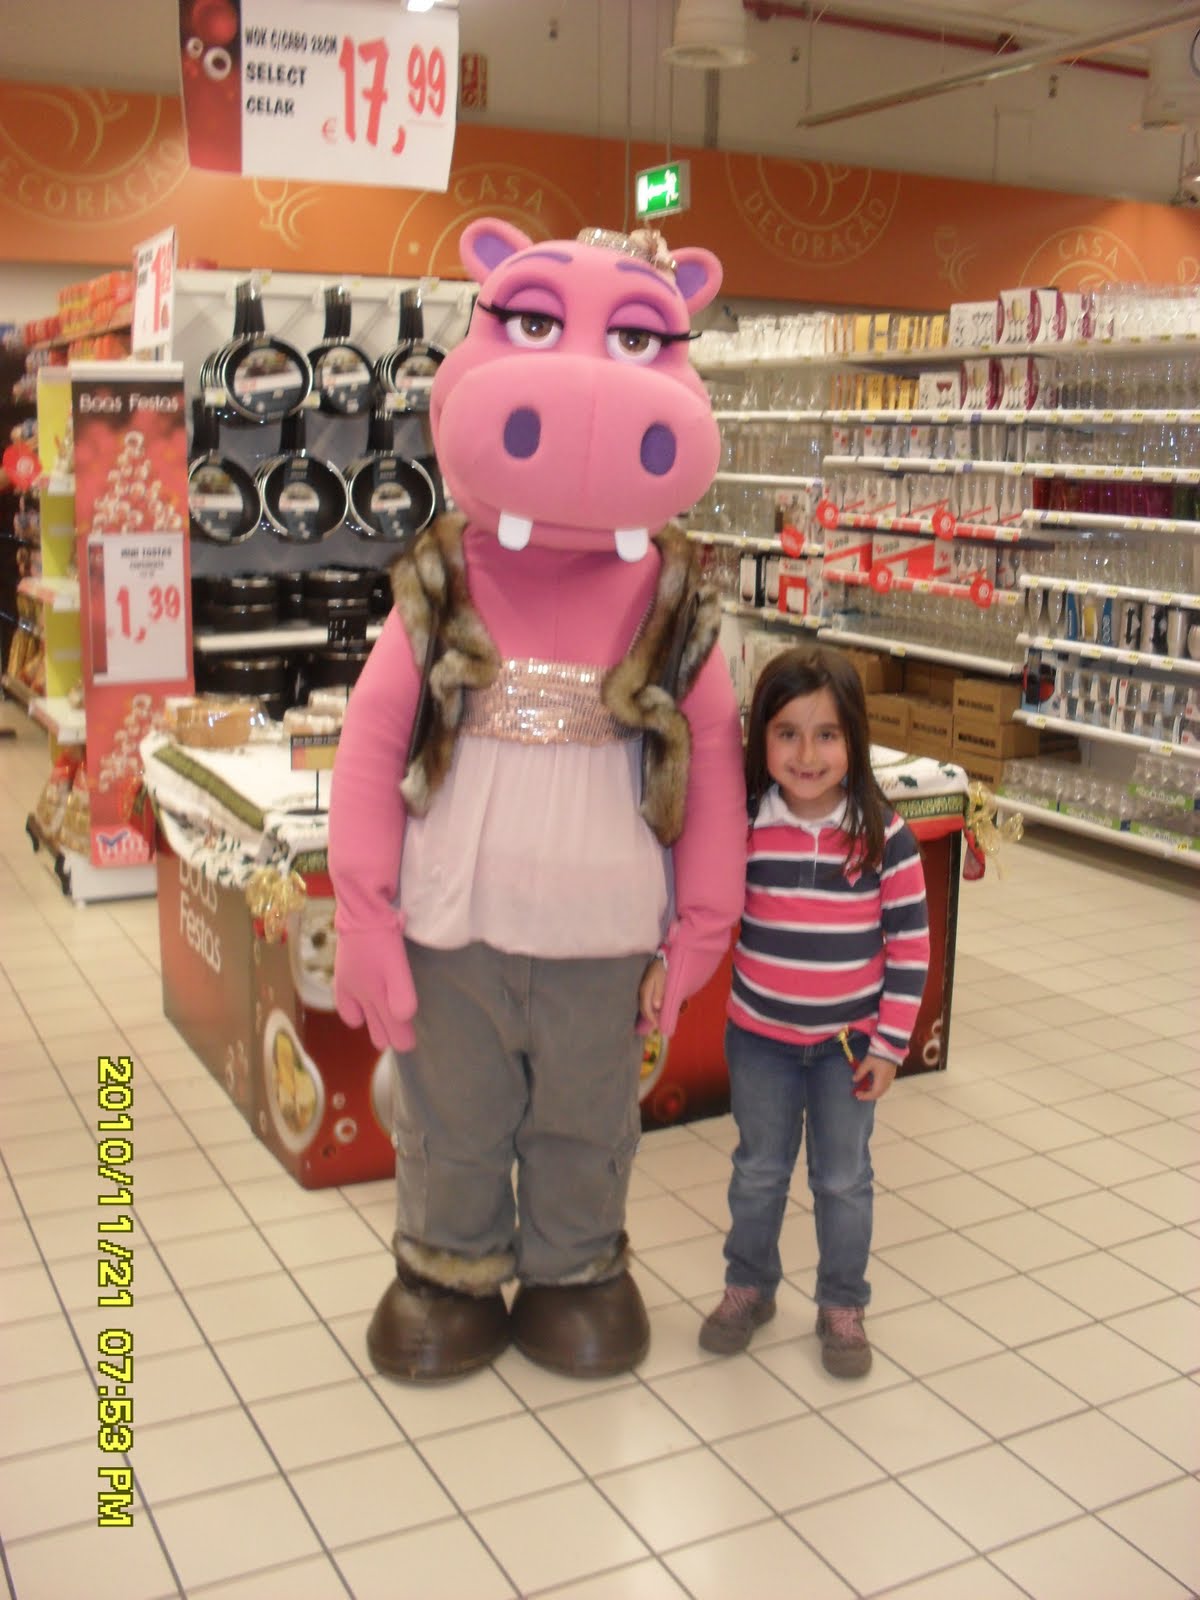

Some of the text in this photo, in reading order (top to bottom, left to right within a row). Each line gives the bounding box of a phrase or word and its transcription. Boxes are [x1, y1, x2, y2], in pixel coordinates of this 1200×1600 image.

[246, 62, 307, 87] SELECT
[246, 95, 295, 116] CELAR
[454, 173, 543, 213] CASA
[1058, 234, 1119, 267] CASA
[79, 392, 179, 414] Boas Festas
